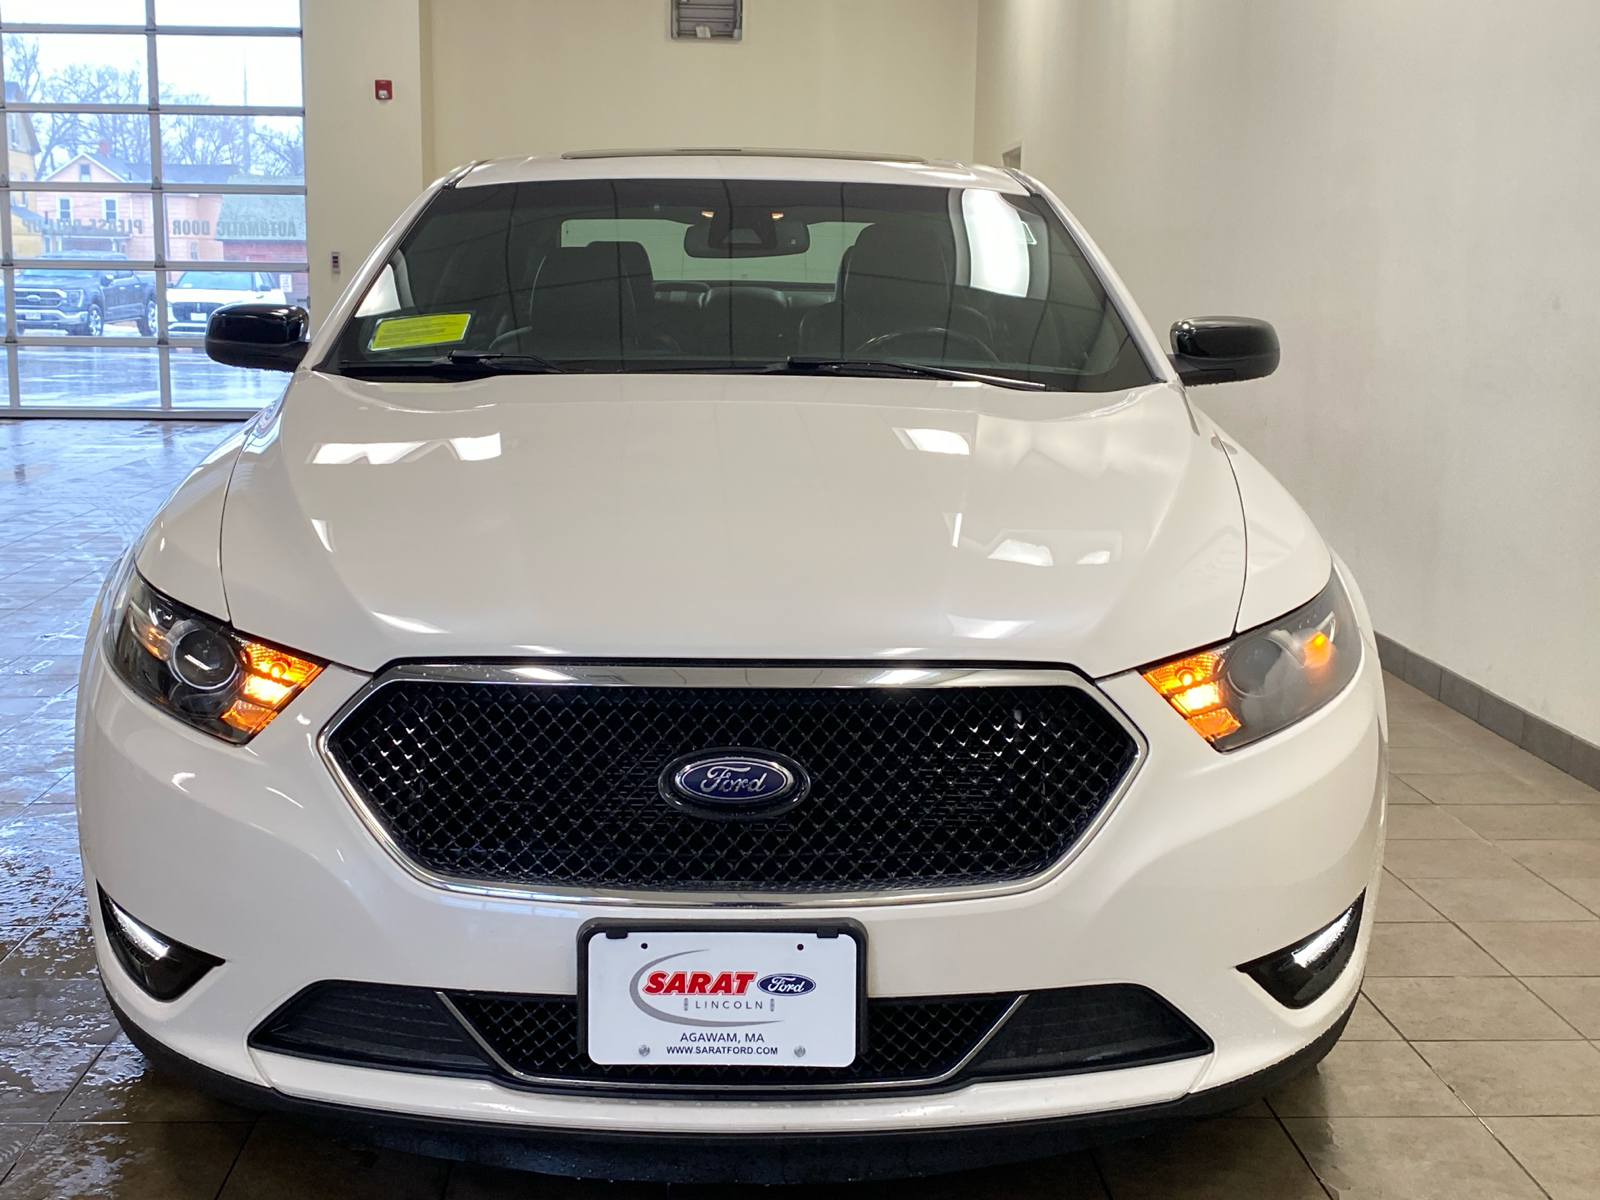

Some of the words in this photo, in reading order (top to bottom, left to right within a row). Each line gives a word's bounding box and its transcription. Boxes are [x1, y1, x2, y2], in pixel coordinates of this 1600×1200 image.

[700, 766, 768, 793] Ford
[643, 971, 758, 996] SARAT
[767, 976, 805, 993] Ford
[695, 1000, 763, 1010] LINCOLN
[680, 1032, 741, 1044] AGAWAM,
[745, 1033, 765, 1043] MA
[666, 1046, 778, 1055] WWW.SARATFORD.COM
